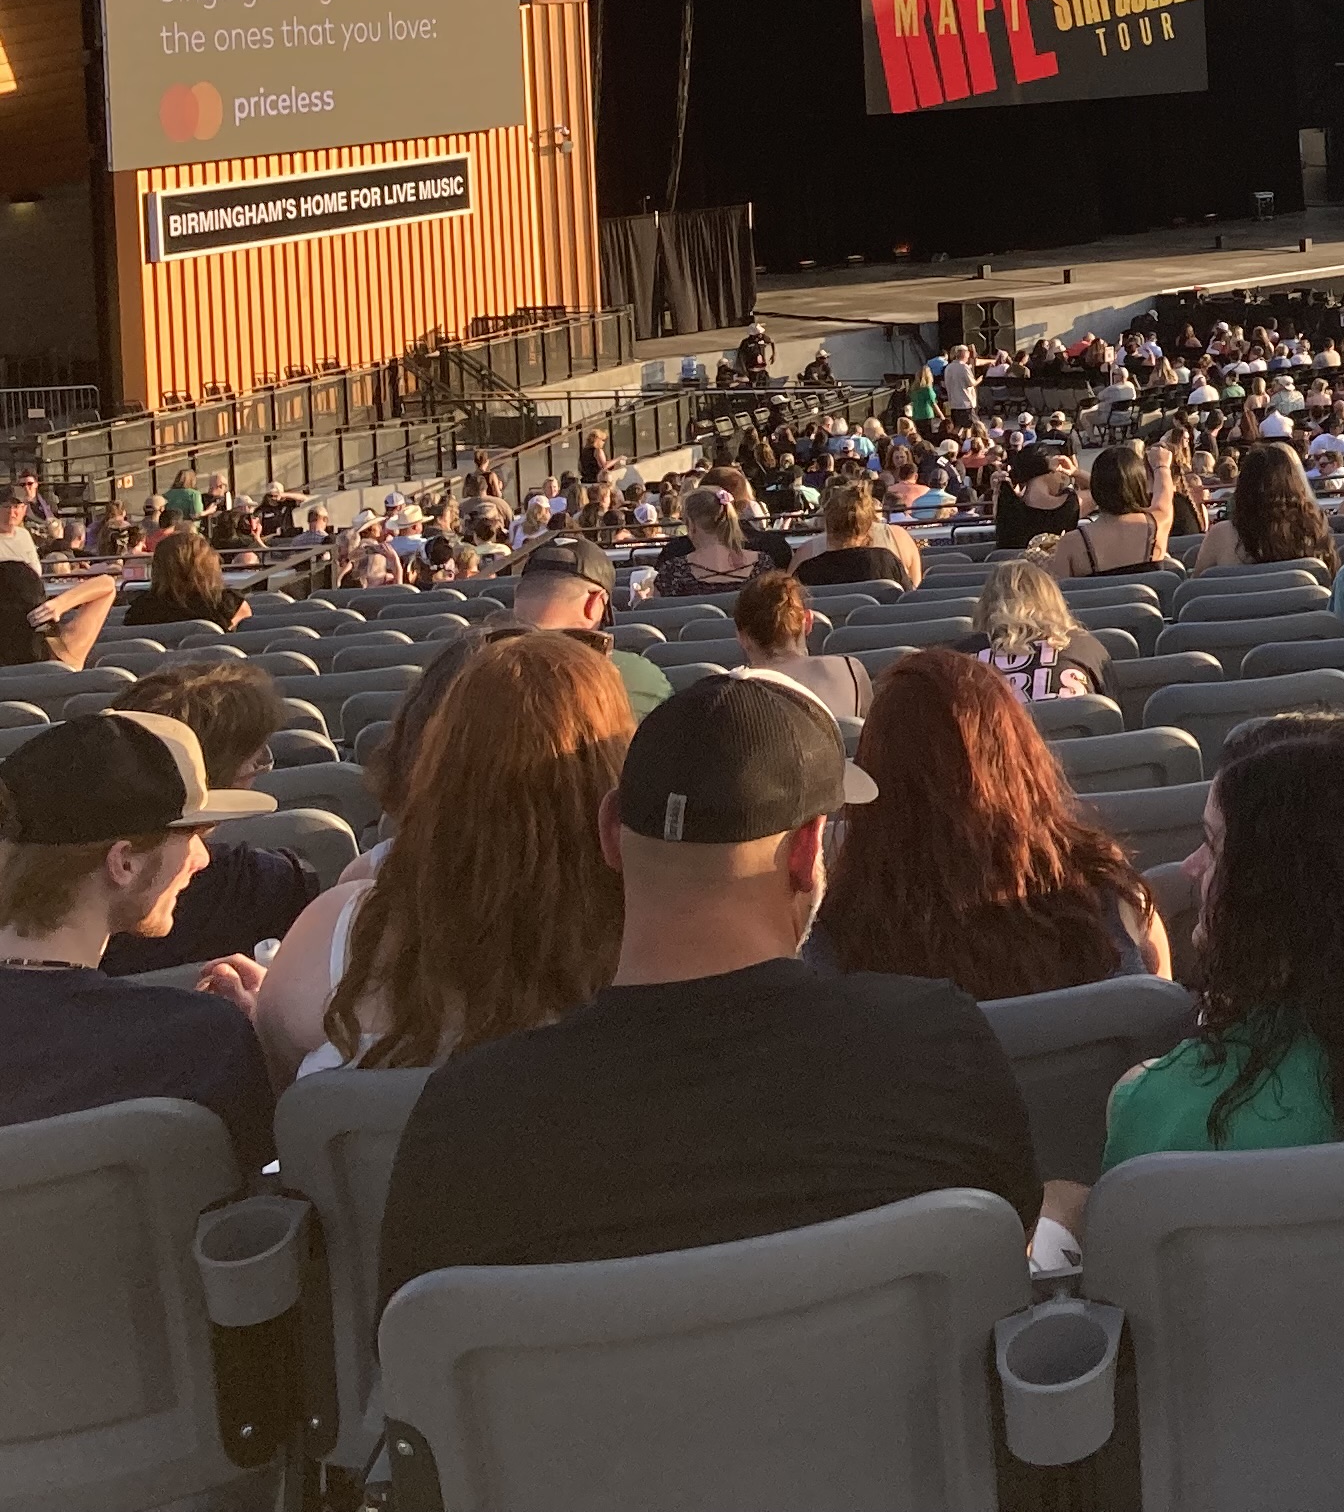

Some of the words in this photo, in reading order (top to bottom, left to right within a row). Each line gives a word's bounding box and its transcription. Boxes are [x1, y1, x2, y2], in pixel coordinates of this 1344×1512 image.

[160, 21, 206, 54] the
[214, 26, 274, 51] ones
[281, 16, 335, 47] that
[341, 21, 381, 51] you
[388, 12, 437, 40] love:
[1095, 13, 1175, 56] TOUR
[234, 86, 335, 126] priceless
[169, 198, 297, 237] BIRMINGHAM'S
[299, 192, 348, 218] HOME
[350, 187, 381, 210] FOR
[383, 182, 416, 206] LIVE
[418, 176, 464, 201] MUSIC
